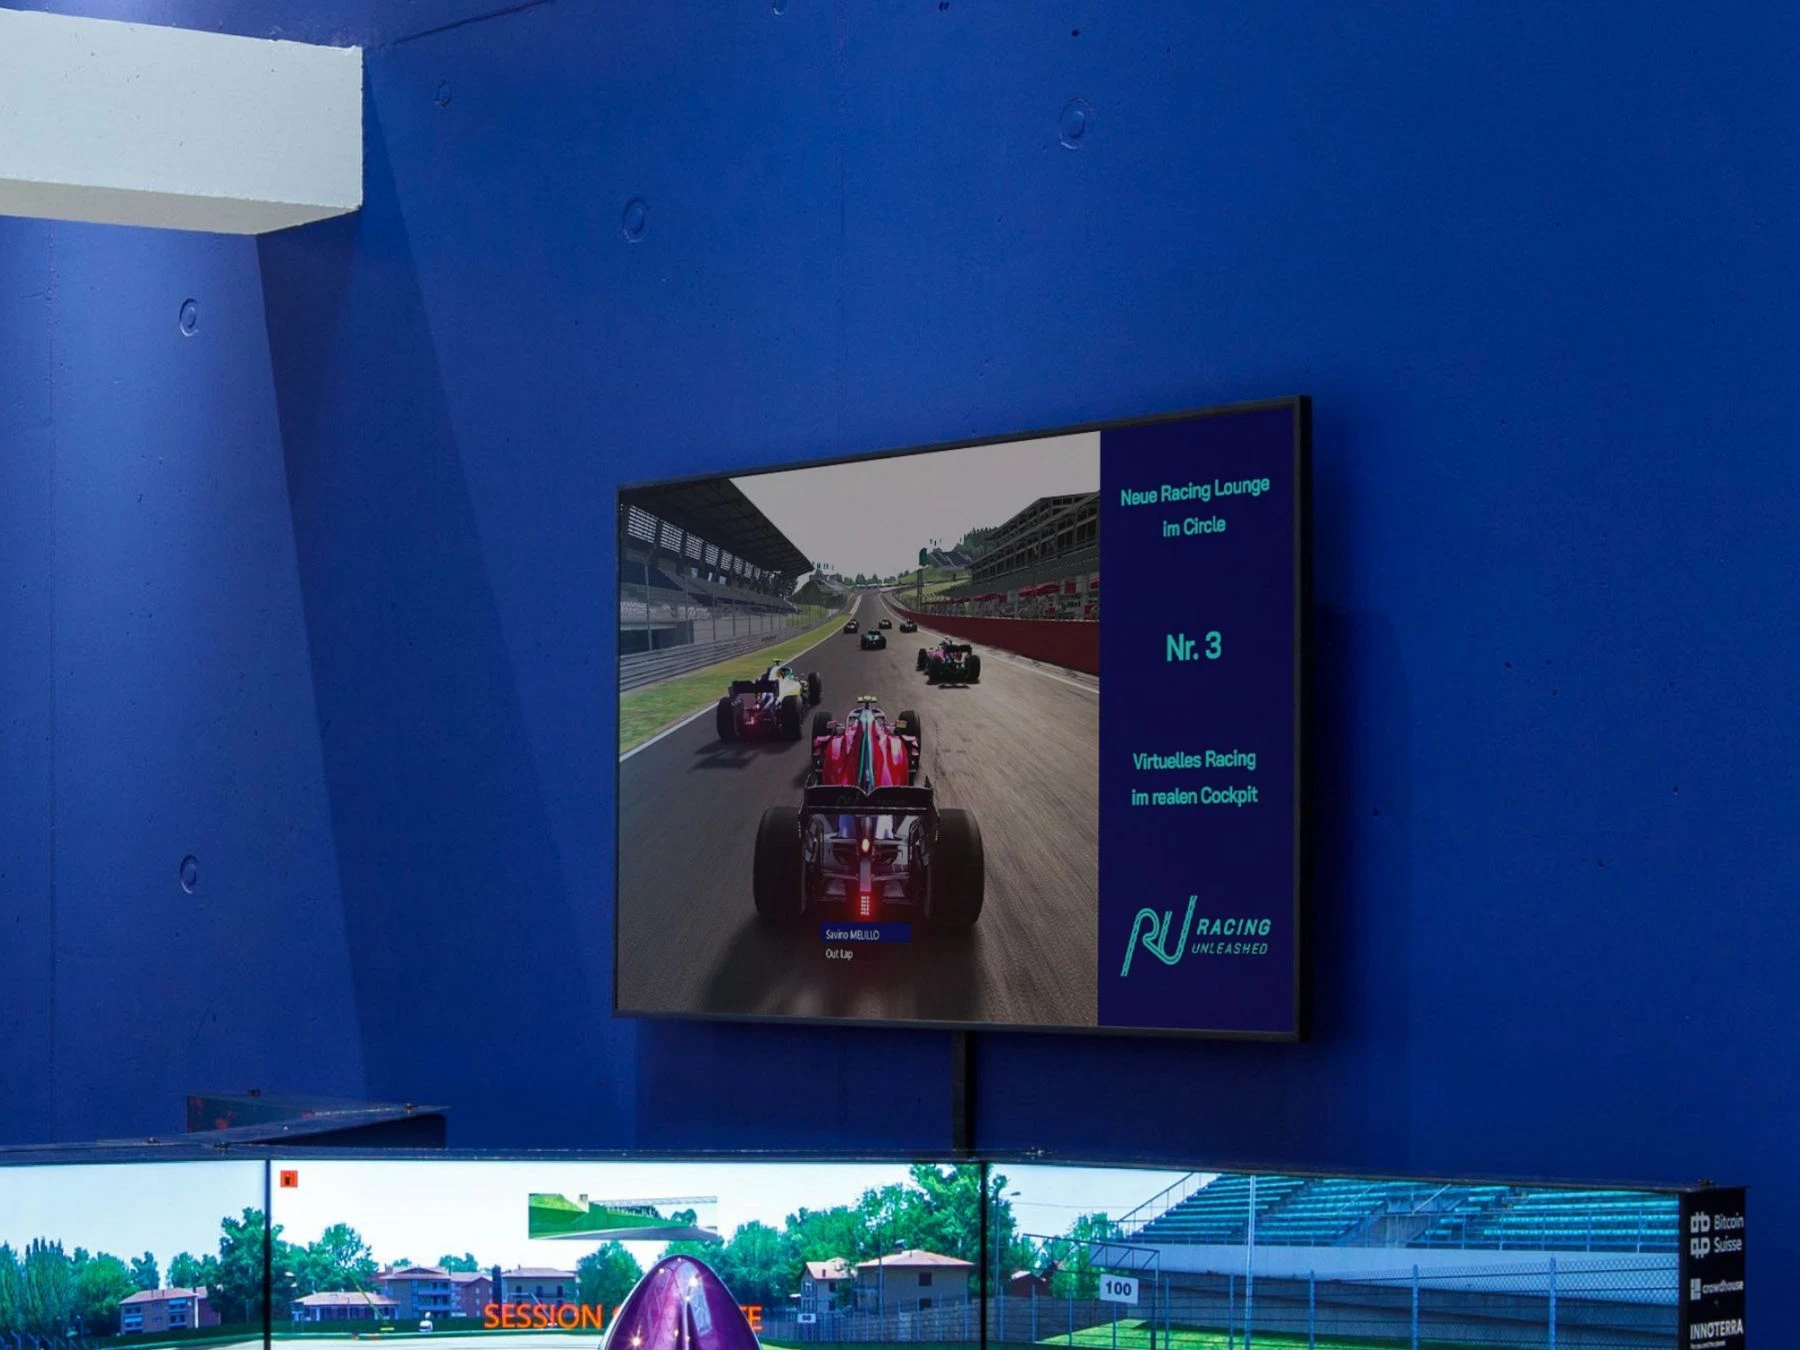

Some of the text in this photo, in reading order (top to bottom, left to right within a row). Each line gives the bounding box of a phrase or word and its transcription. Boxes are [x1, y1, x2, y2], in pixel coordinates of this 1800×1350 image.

[1120, 477, 1270, 507] Neue Racing Lounge
[1163, 515, 1226, 538] im Circle
[1165, 631, 1223, 663] Nr. 3
[1132, 749, 1257, 771] Virtuelles Racing
[1131, 785, 1259, 807] im realen Cockpit
[1196, 918, 1271, 936] RACING
[825, 948, 839, 959] Out
[1191, 942, 1268, 955] UNLEASHED
[1714, 1212, 1744, 1231] Bitcoin
[1714, 1235, 1742, 1253] Suisse
[1104, 1281, 1133, 1298] 100
[1703, 1280, 1744, 1294] crowdhouse
[483, 1303, 602, 1329] SESSION
[1690, 1318, 1744, 1340] INNOTERRA
